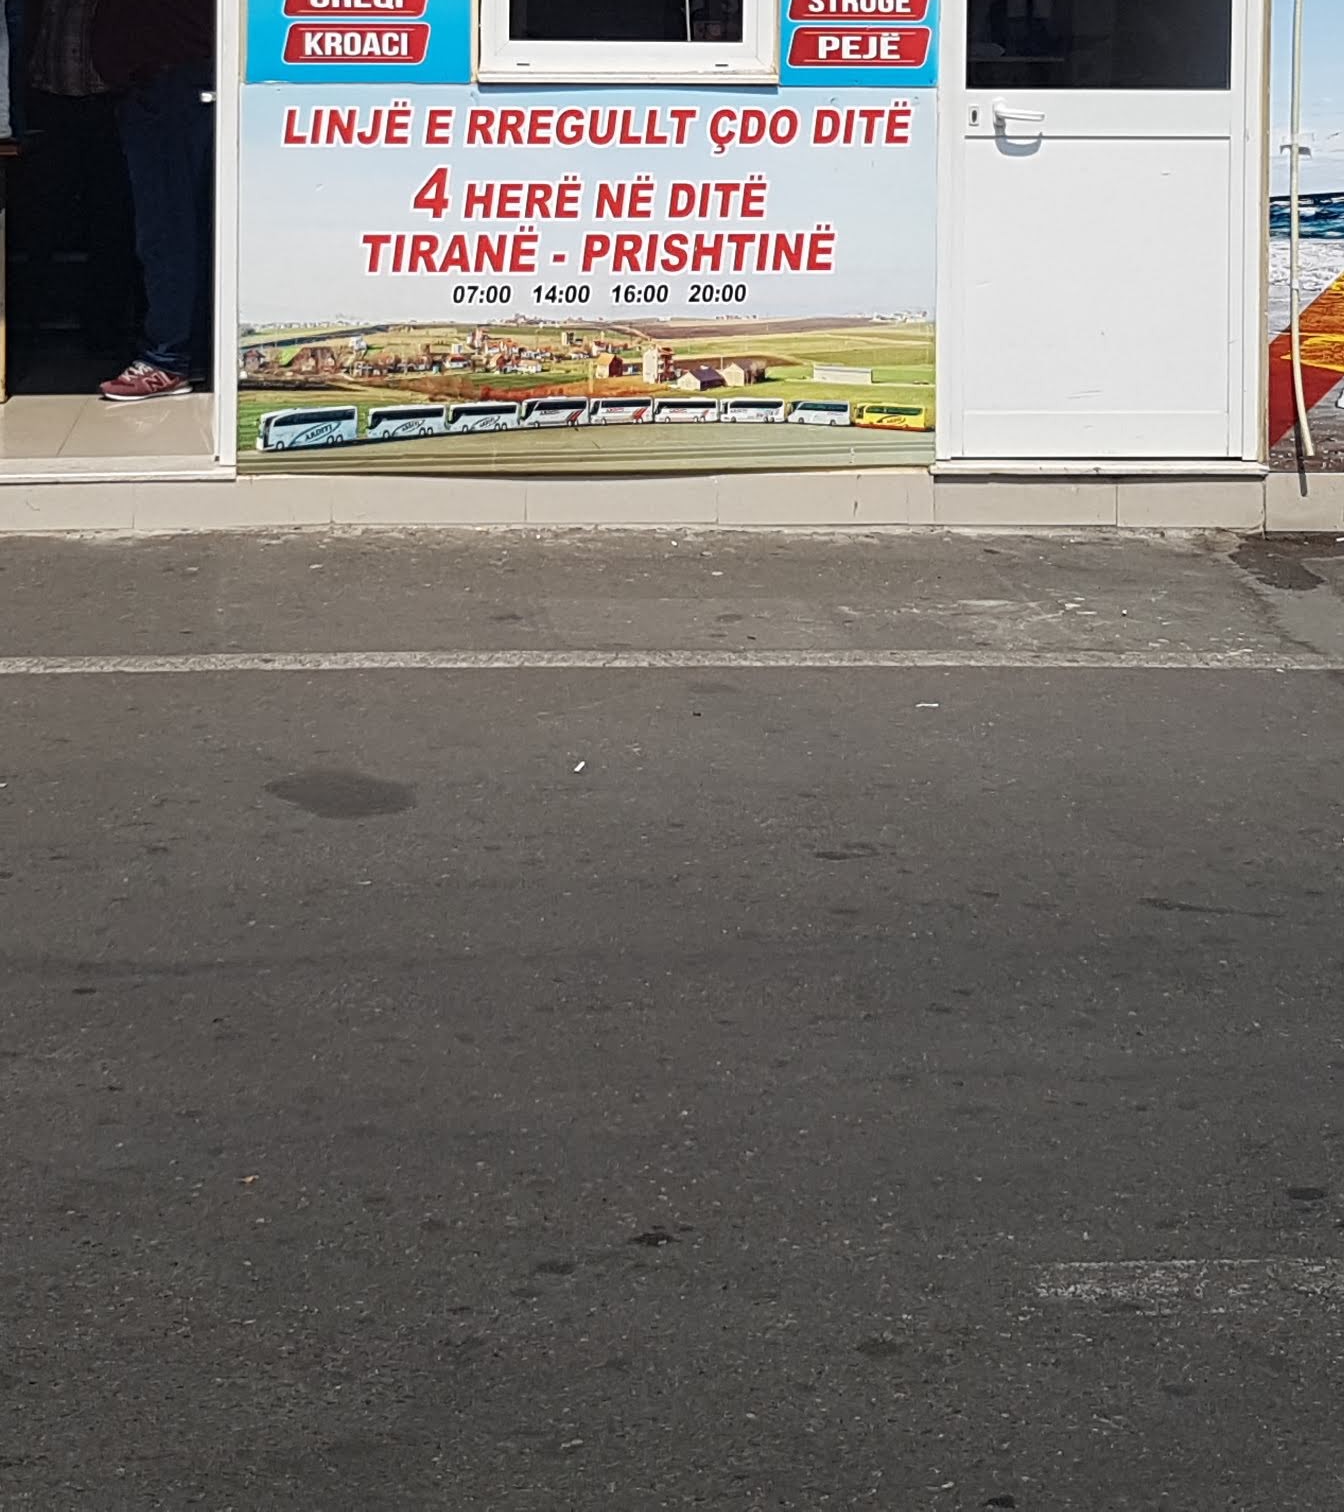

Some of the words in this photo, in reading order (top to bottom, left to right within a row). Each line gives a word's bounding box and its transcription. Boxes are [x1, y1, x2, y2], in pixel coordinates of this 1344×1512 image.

[304, 31, 408, 56] KROACI
[817, 32, 900, 60] PEJË
[283, 101, 412, 145] LINJË
[425, 109, 453, 145] E
[466, 108, 697, 145] RREGULLT
[709, 108, 799, 154] ÇDO
[812, 101, 912, 145] DITË
[413, 167, 450, 219] 4
[464, 175, 582, 219] HERË
[595, 175, 654, 218] NË
[667, 174, 767, 218] DITË
[361, 225, 539, 273] TIRANË
[581, 224, 836, 272] PRISHTINË
[452, 285, 512, 304] 07:00
[532, 285, 591, 304] 14:00
[611, 284, 669, 304] 16:00
[688, 284, 747, 303] 20:00
